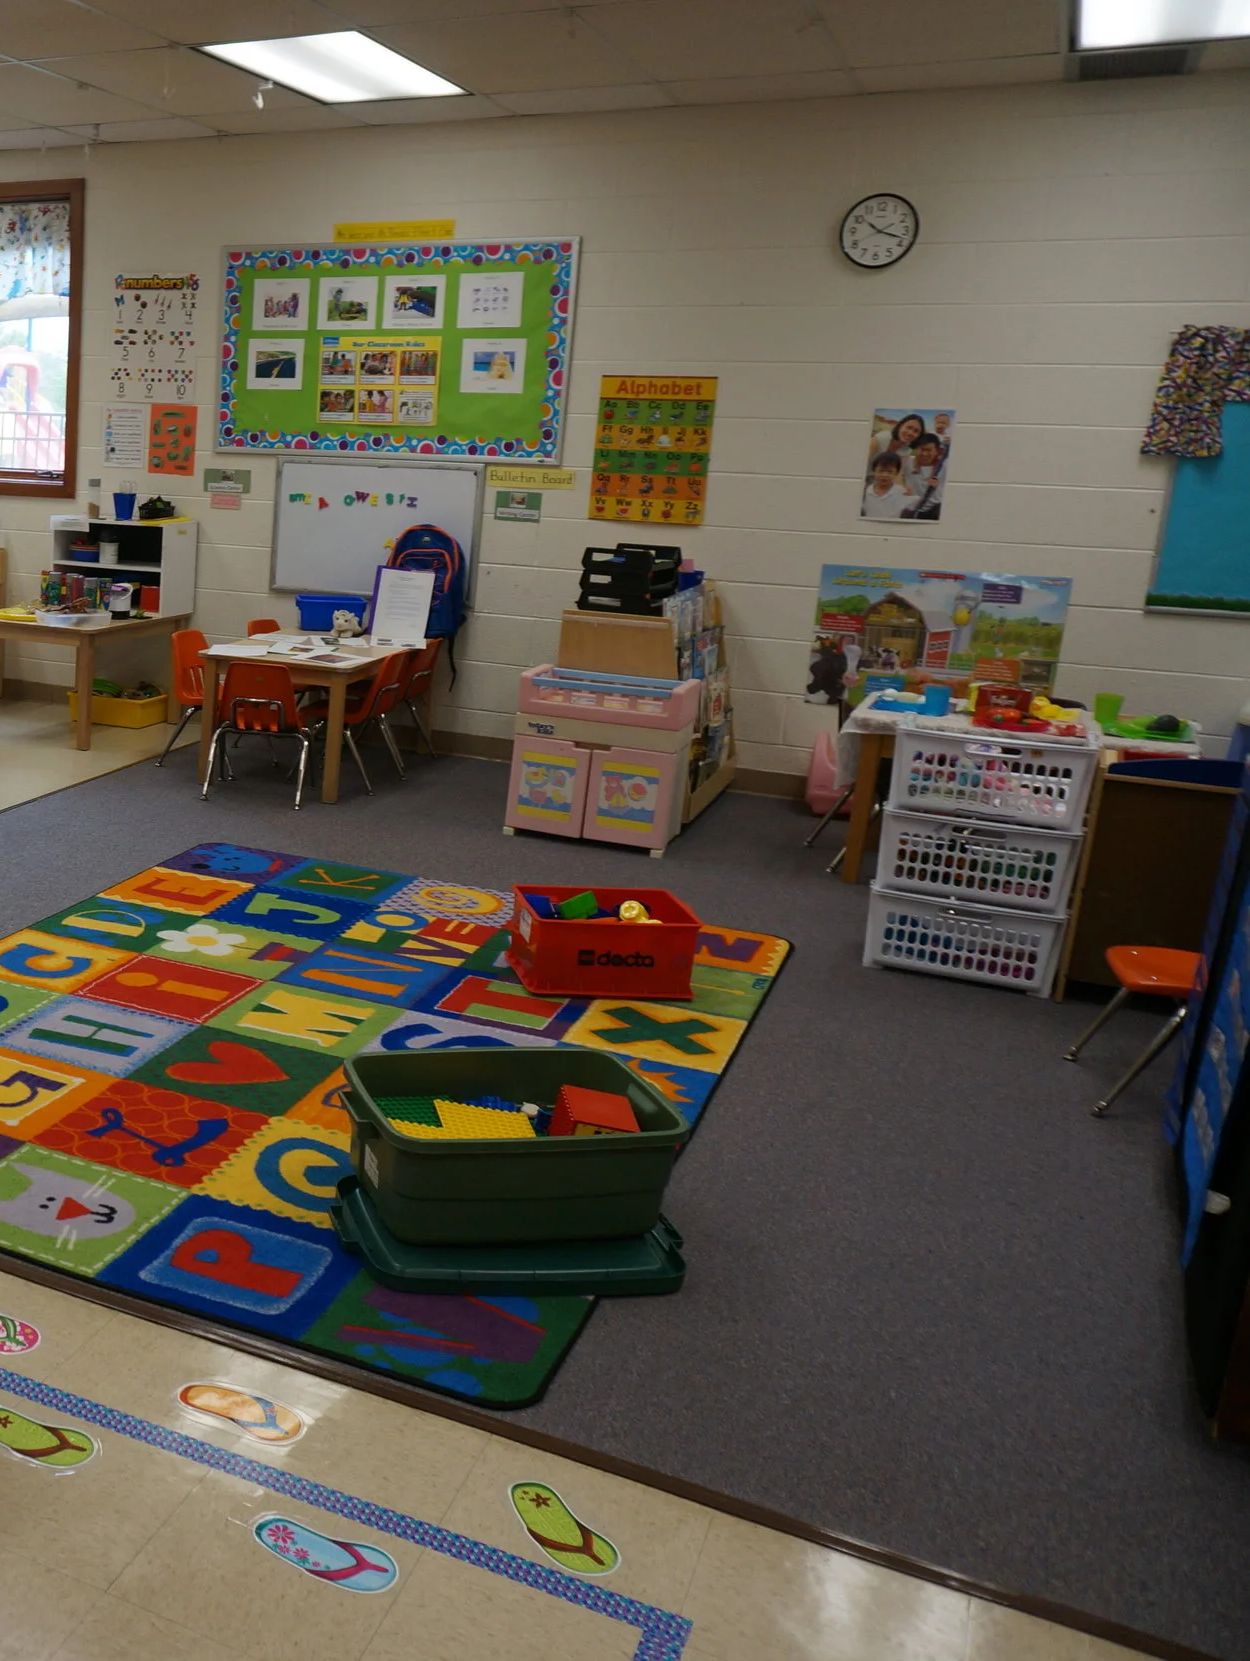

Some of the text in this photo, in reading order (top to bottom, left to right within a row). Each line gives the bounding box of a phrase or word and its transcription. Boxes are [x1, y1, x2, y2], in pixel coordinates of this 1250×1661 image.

[877, 202, 888, 212] 12
[853, 214, 864, 225] 10
[899, 213, 908, 224] 2
[850, 226, 857, 237] 9
[902, 225, 910, 237] 3
[872, 251, 879, 261] 6
[885, 247, 894, 258] 5
[125, 274, 184, 291] numbers
[136, 308, 144, 321] 2
[158, 309, 165, 321] 3
[184, 309, 193, 321] 4
[122, 346, 186, 359] 5 6 7
[117, 382, 125, 394] 8
[145, 383, 153, 394] 9
[176, 384, 187, 396] 10
[616, 379, 704, 397] Alphabet
[490, 469, 573, 485] Bulletin Board
[131, 877, 231, 905] E
[61, 909, 147, 938] D
[28, 1014, 156, 1057] H
[591, 1005, 721, 1056] X
[170, 1229, 306, 1299] P
